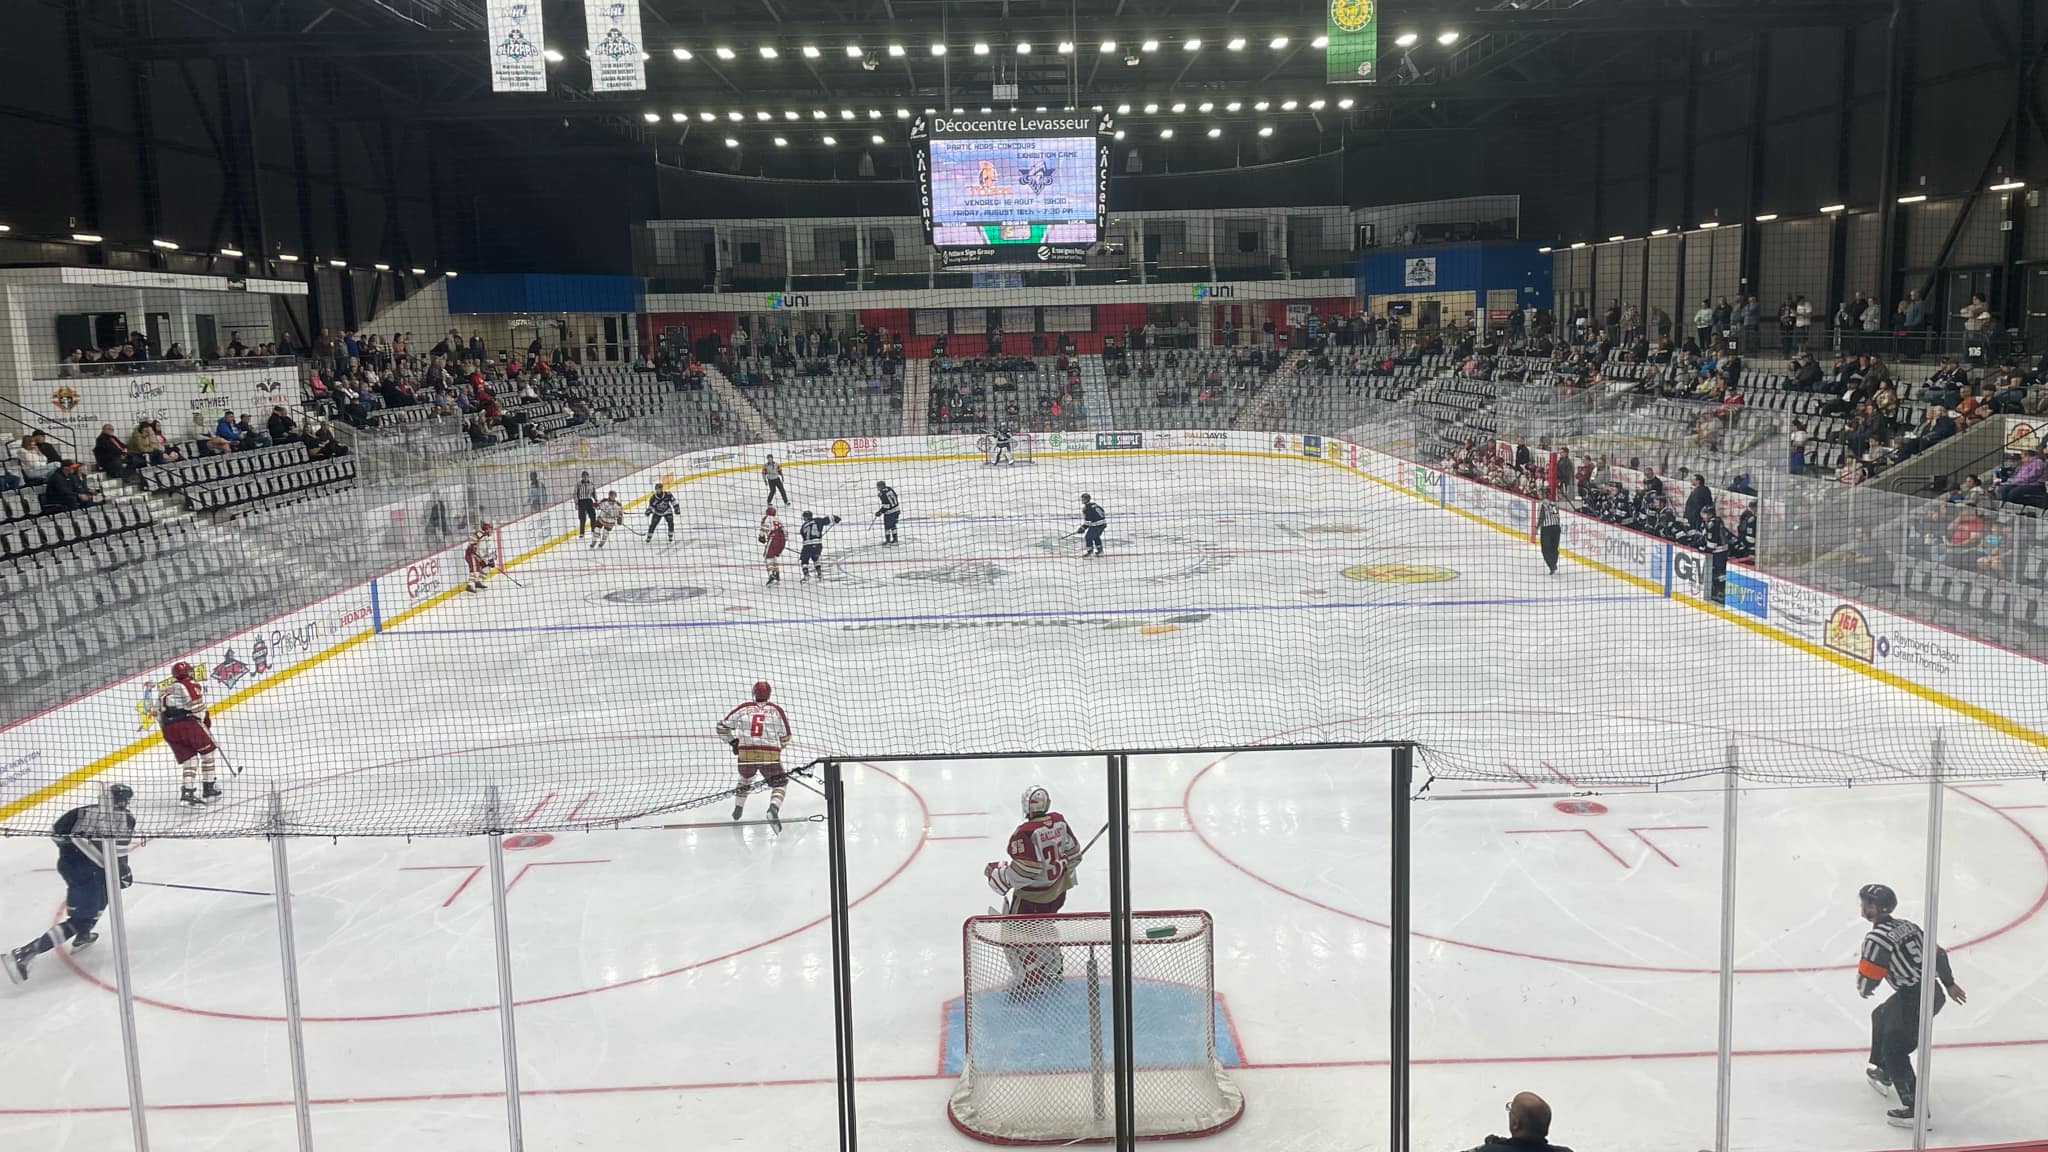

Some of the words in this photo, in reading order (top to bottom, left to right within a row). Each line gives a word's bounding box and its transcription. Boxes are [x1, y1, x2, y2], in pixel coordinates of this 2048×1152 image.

[935, 117, 1017, 133] Décocentre
[1020, 116, 1090, 131] Levasseur
[918, 158, 931, 231] Accent
[1098, 155, 1108, 228] Accent
[190, 396, 229, 410] NORTHWEST
[853, 438, 878, 449] BOB'S
[803, 523, 820, 540] 74
[1604, 535, 1646, 565] primus
[340, 605, 372, 628] HONDA
[1839, 613, 1858, 633] IGA
[1893, 631, 1930, 654] Raymond
[1930, 642, 1960, 665] Chabot
[751, 715, 765, 737] 6
